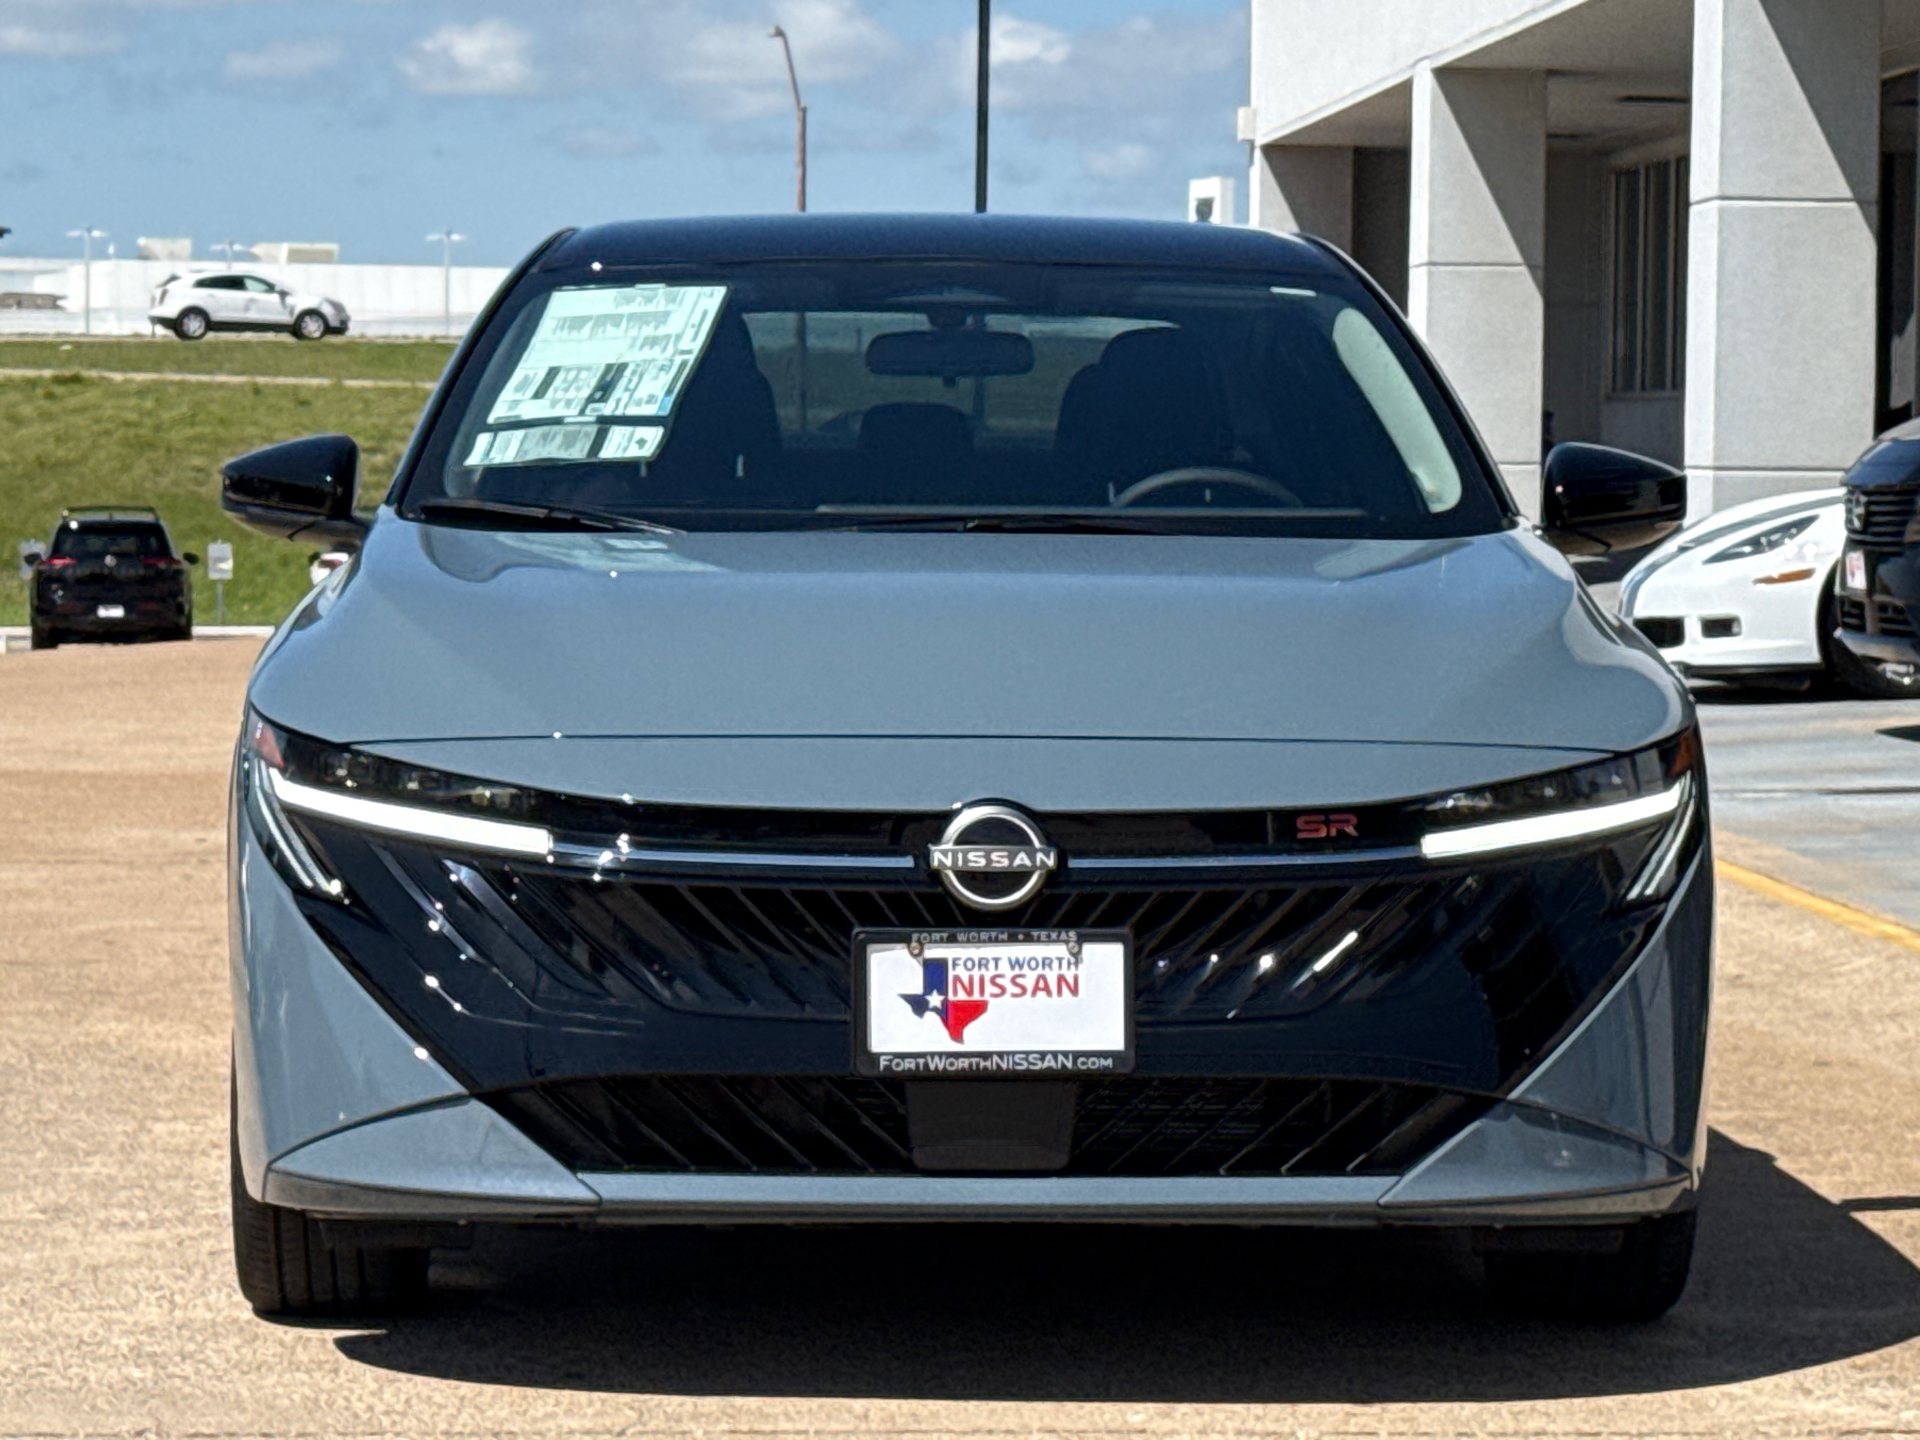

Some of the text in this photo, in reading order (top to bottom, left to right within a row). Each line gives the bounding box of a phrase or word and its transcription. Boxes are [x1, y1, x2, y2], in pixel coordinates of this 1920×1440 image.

[1296, 813, 1359, 839] SR
[933, 850, 1056, 868] NISSAN
[911, 931, 1078, 943] FORT WORTH TEXAS
[951, 956, 1080, 972] FORT WORTH
[951, 973, 1080, 998] NISSAN
